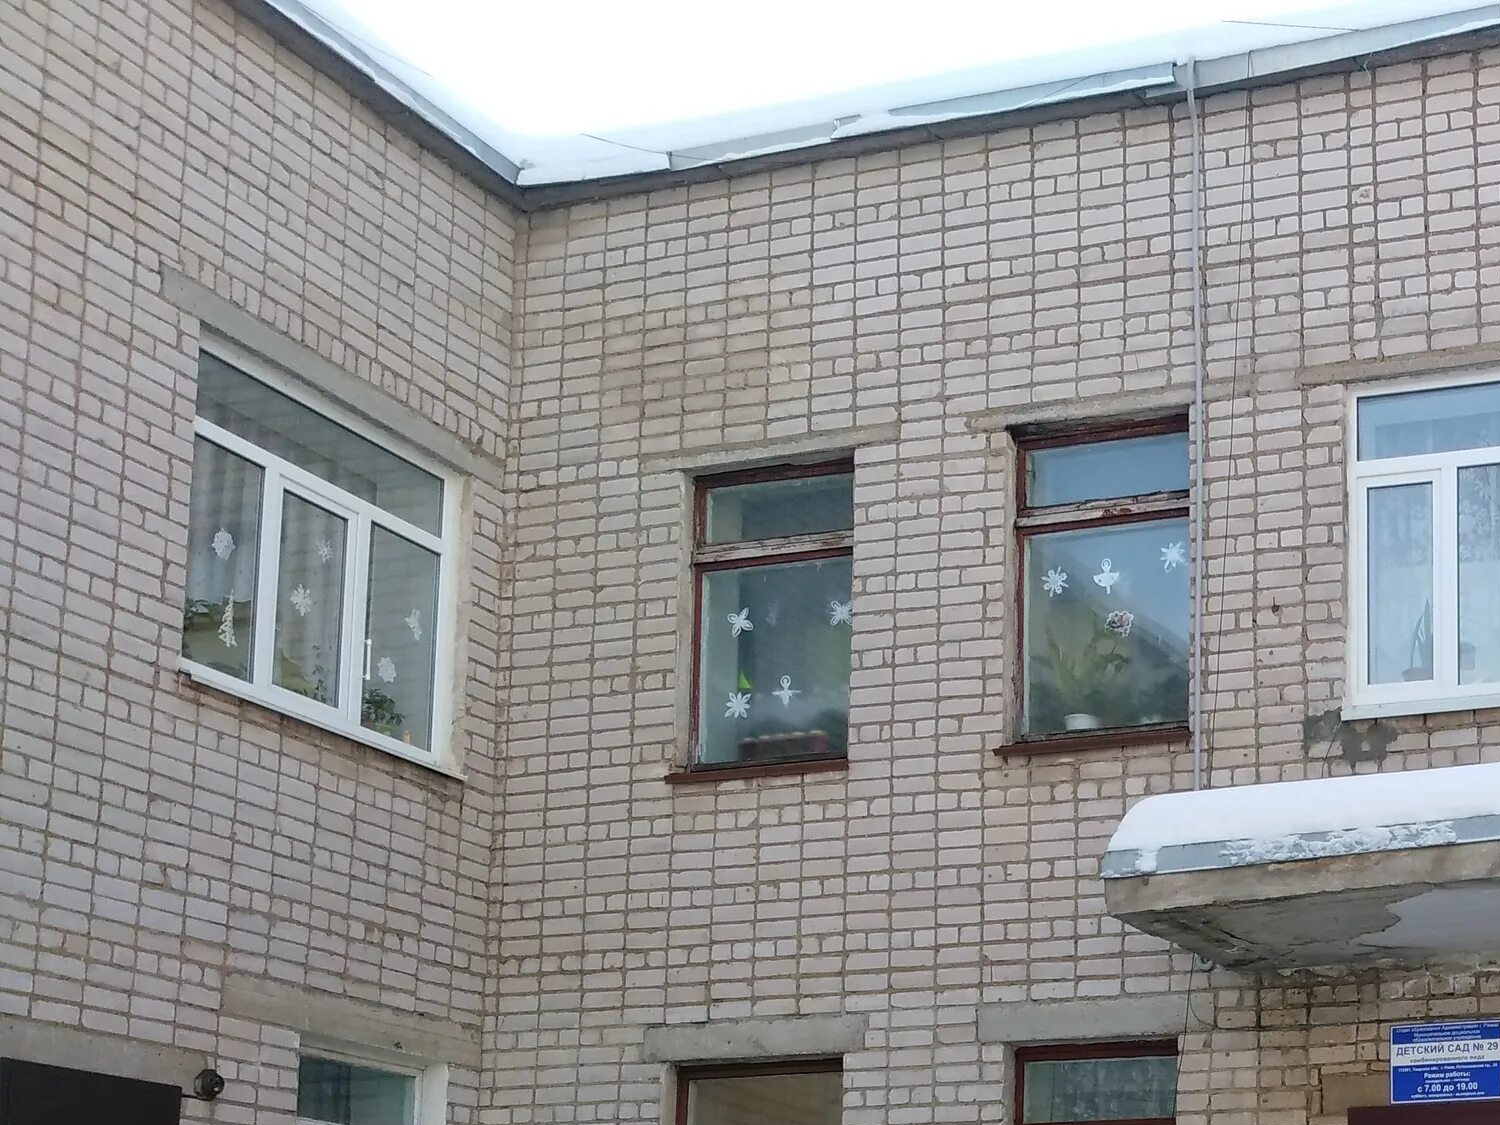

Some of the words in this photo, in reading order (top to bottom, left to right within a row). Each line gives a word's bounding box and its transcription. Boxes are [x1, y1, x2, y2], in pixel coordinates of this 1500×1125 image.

[1396, 1044, 1444, 1057] ДЕТСКИЙ
[1447, 1043, 1470, 1053] САД
[1472, 1042, 1484, 1051] №
[1487, 1042, 1498, 1050] 29
[1424, 1084, 1441, 1092] 7.00
[1456, 1082, 1478, 1091] 19.00
